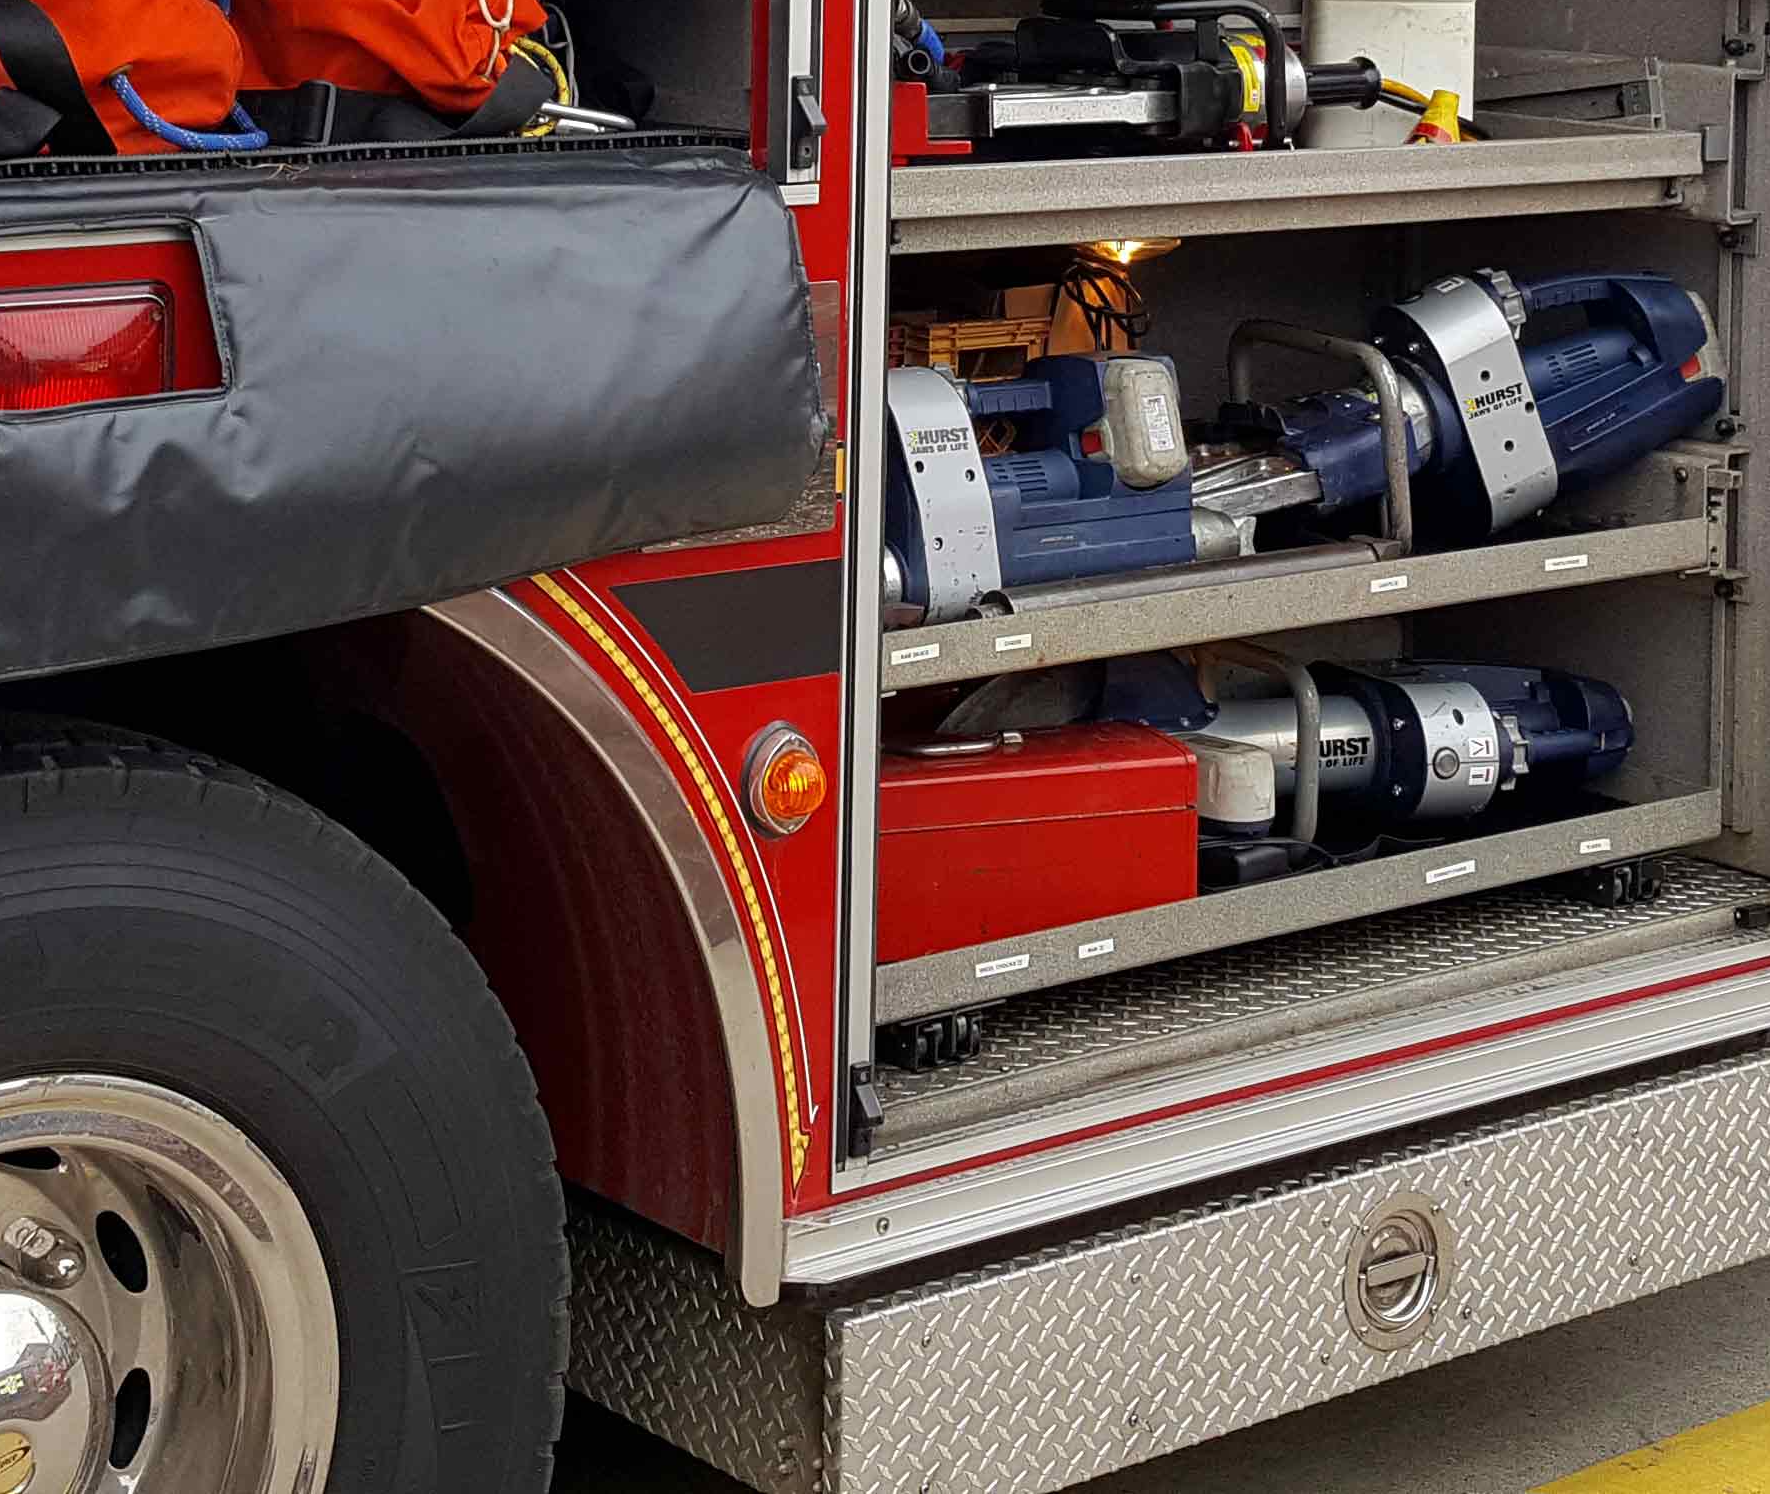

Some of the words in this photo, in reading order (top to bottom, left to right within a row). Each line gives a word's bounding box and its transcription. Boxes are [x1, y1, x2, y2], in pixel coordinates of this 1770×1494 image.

[1474, 382, 1524, 409] HURST
[1469, 407, 1491, 420] JAWS
[1493, 402, 1504, 411] OF
[918, 427, 969, 445] HURST
[950, 442, 969, 451] LIFE
[1319, 736, 1371, 758] URST
[1326, 759, 1341, 768] OF
